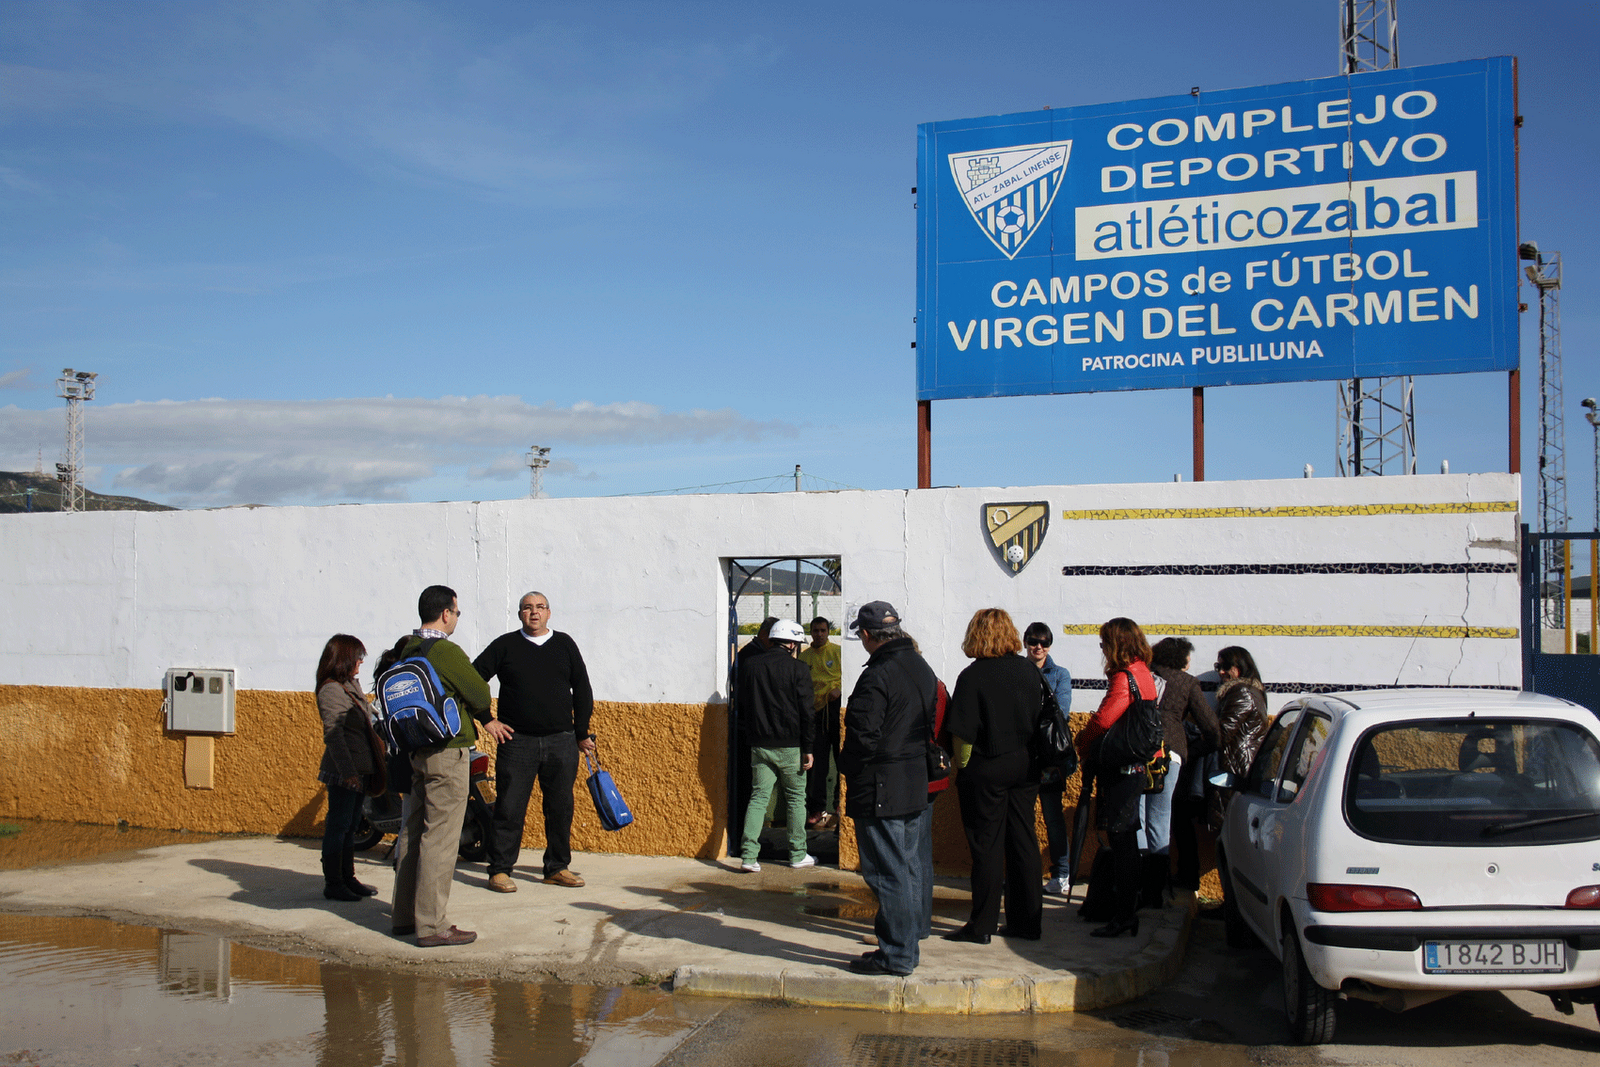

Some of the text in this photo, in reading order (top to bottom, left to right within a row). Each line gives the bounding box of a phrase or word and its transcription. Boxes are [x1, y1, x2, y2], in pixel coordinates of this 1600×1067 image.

[1107, 91, 1438, 150] COMPLEJO
[973, 151, 1062, 204] ATL. ZABAL LINENSE
[1102, 133, 1448, 192] DEPORTIVO
[1094, 179, 1457, 252] atléticozabal
[991, 249, 1429, 308] CAMPOS de FÚTBOL
[948, 285, 1479, 351] VIRGEN DEL CARMEN
[1083, 340, 1324, 371] PATROCINA PUBLILUNA
[1444, 943, 1558, 965] 1842 BJH
